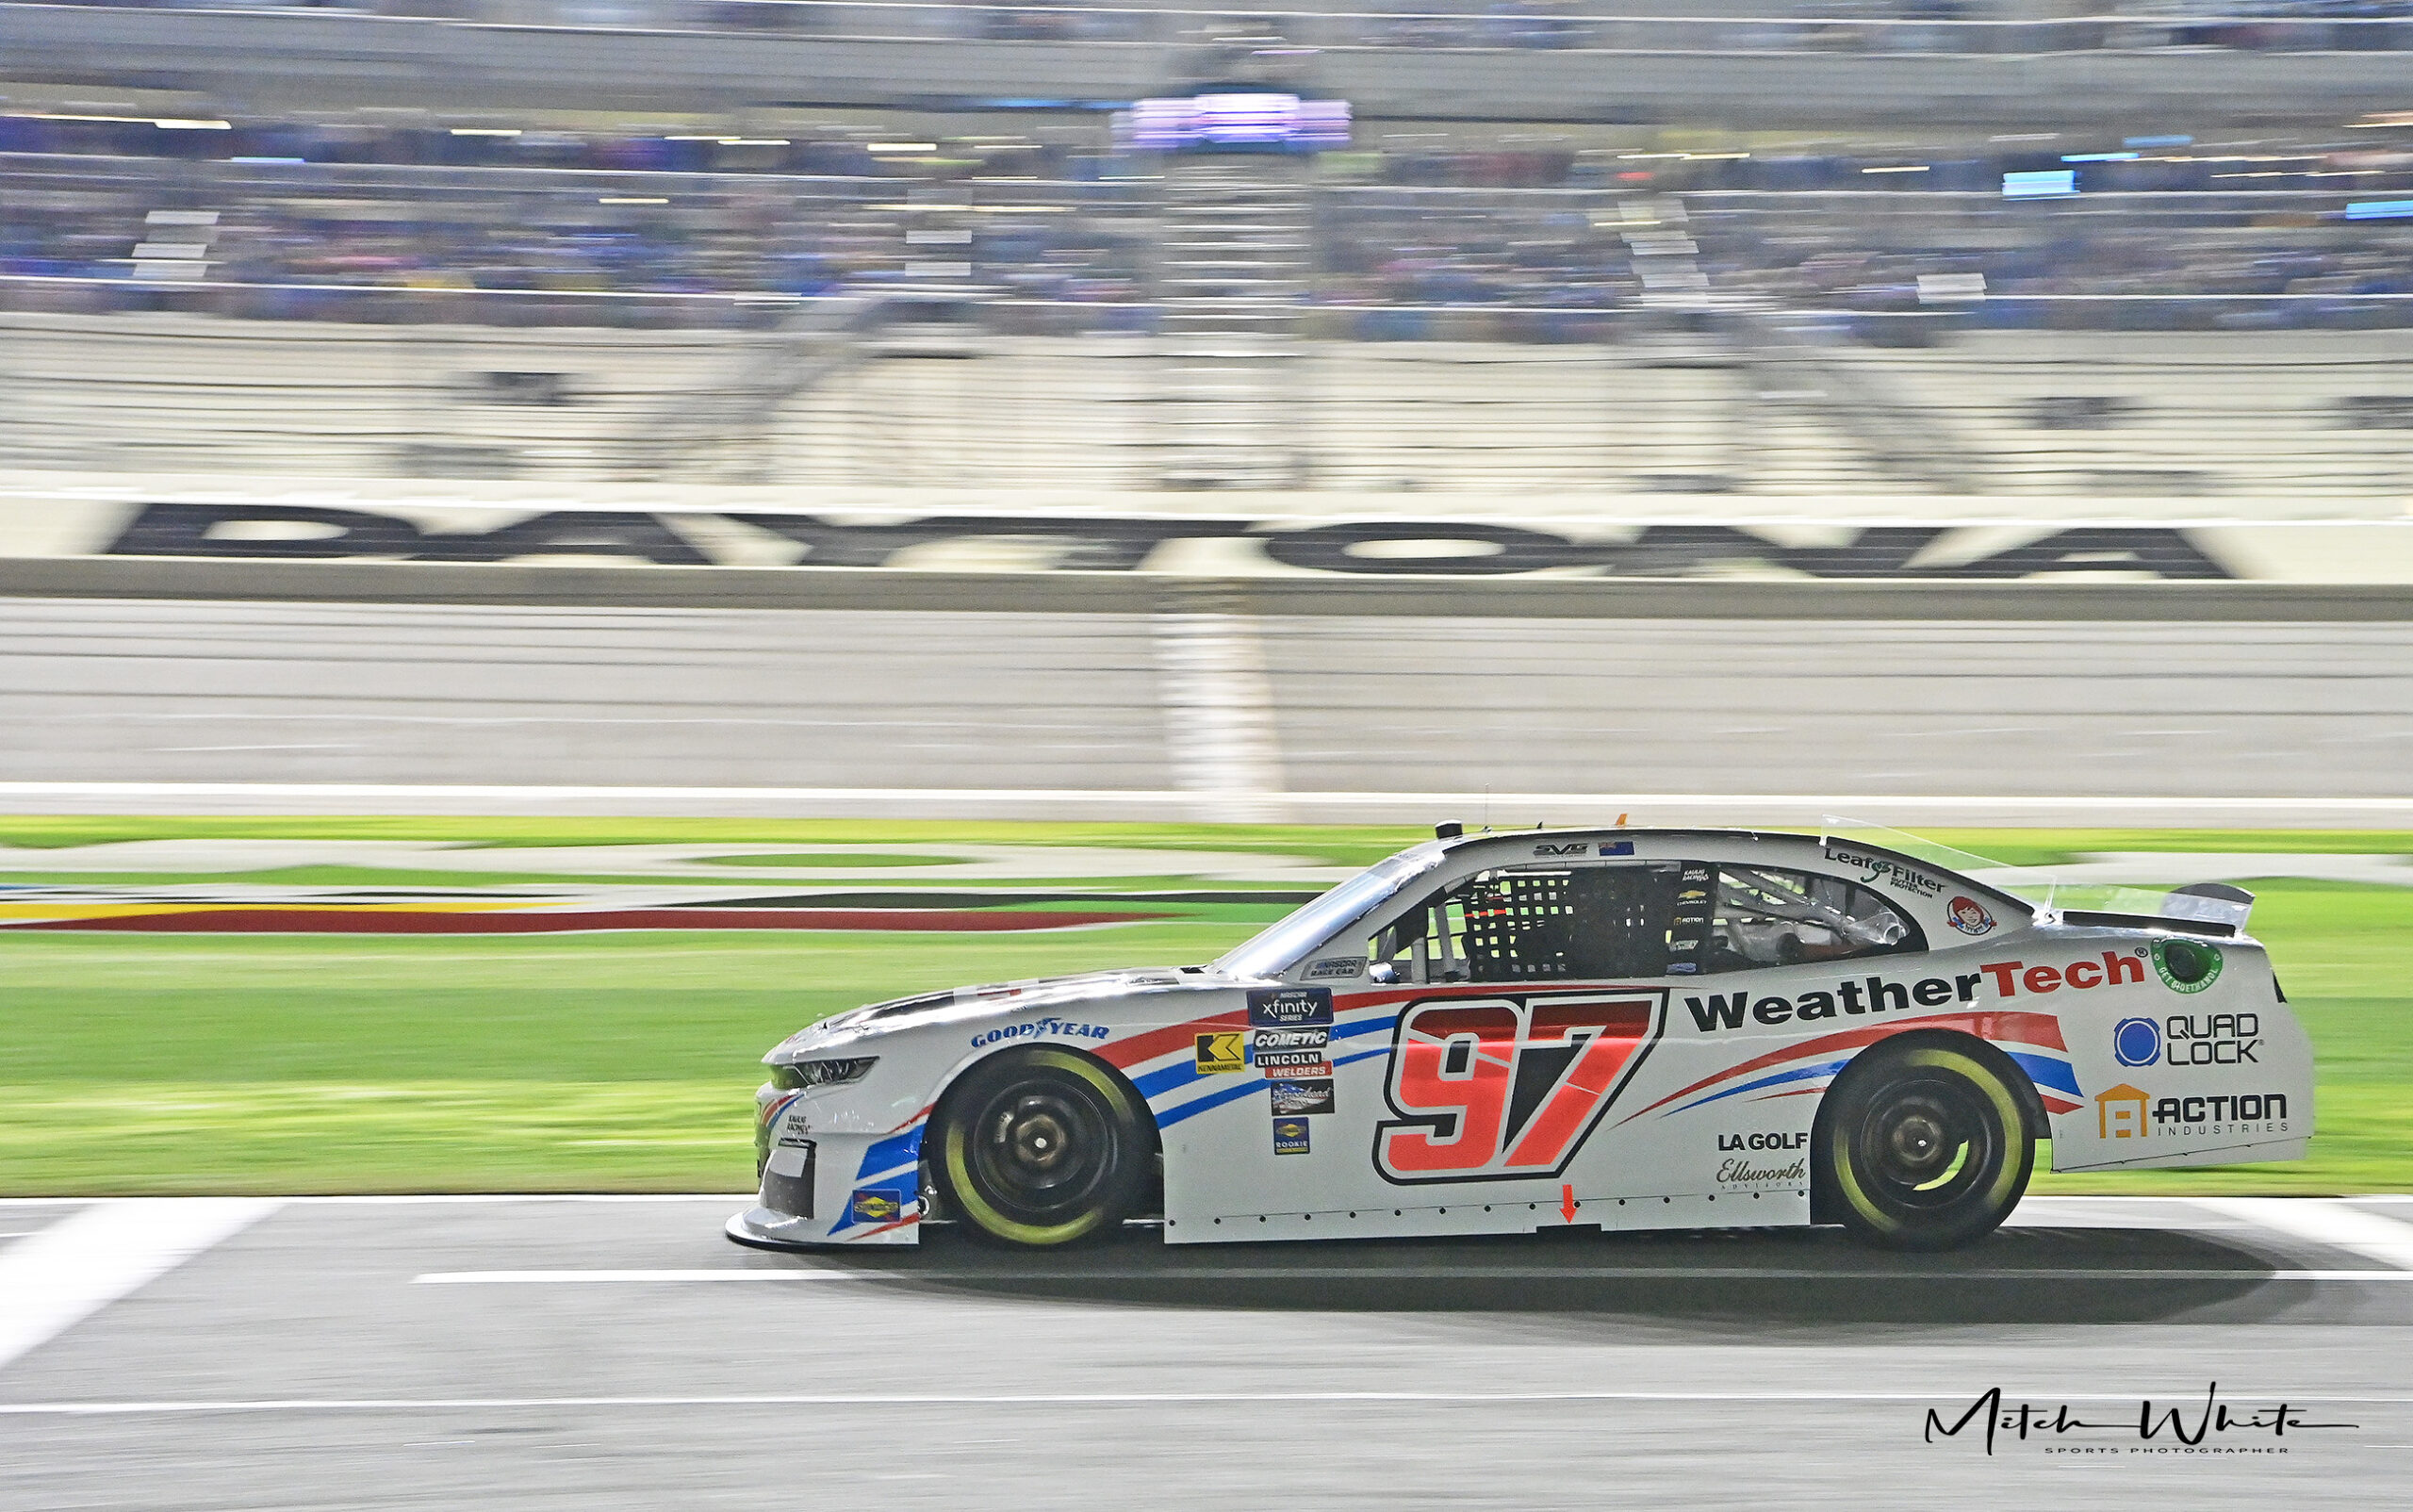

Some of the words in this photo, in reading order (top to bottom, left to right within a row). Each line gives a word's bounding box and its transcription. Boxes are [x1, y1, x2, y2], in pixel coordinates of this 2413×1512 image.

[102, 502, 2251, 581] DAYTONA
[1262, 999, 1318, 1019] xfinity
[1279, 1013, 1303, 1022] SERIES
[2166, 1012, 2258, 1040] QUAD
[1255, 1031, 1327, 1047] COMETIC
[1257, 1053, 1319, 1066] LINCOLN
[2166, 1039, 2258, 1066] LOCK
[1272, 1066, 1326, 1077] WELDERS
[1371, 988, 1670, 1186] 97
[2152, 1093, 2287, 1124] ACTION
[2158, 1122, 2289, 1137] INDUSTRIES
[1717, 1134, 1746, 1151] LA
[1748, 1132, 1808, 1150] GOLF
[1715, 1158, 1807, 1183] Ellsworth
